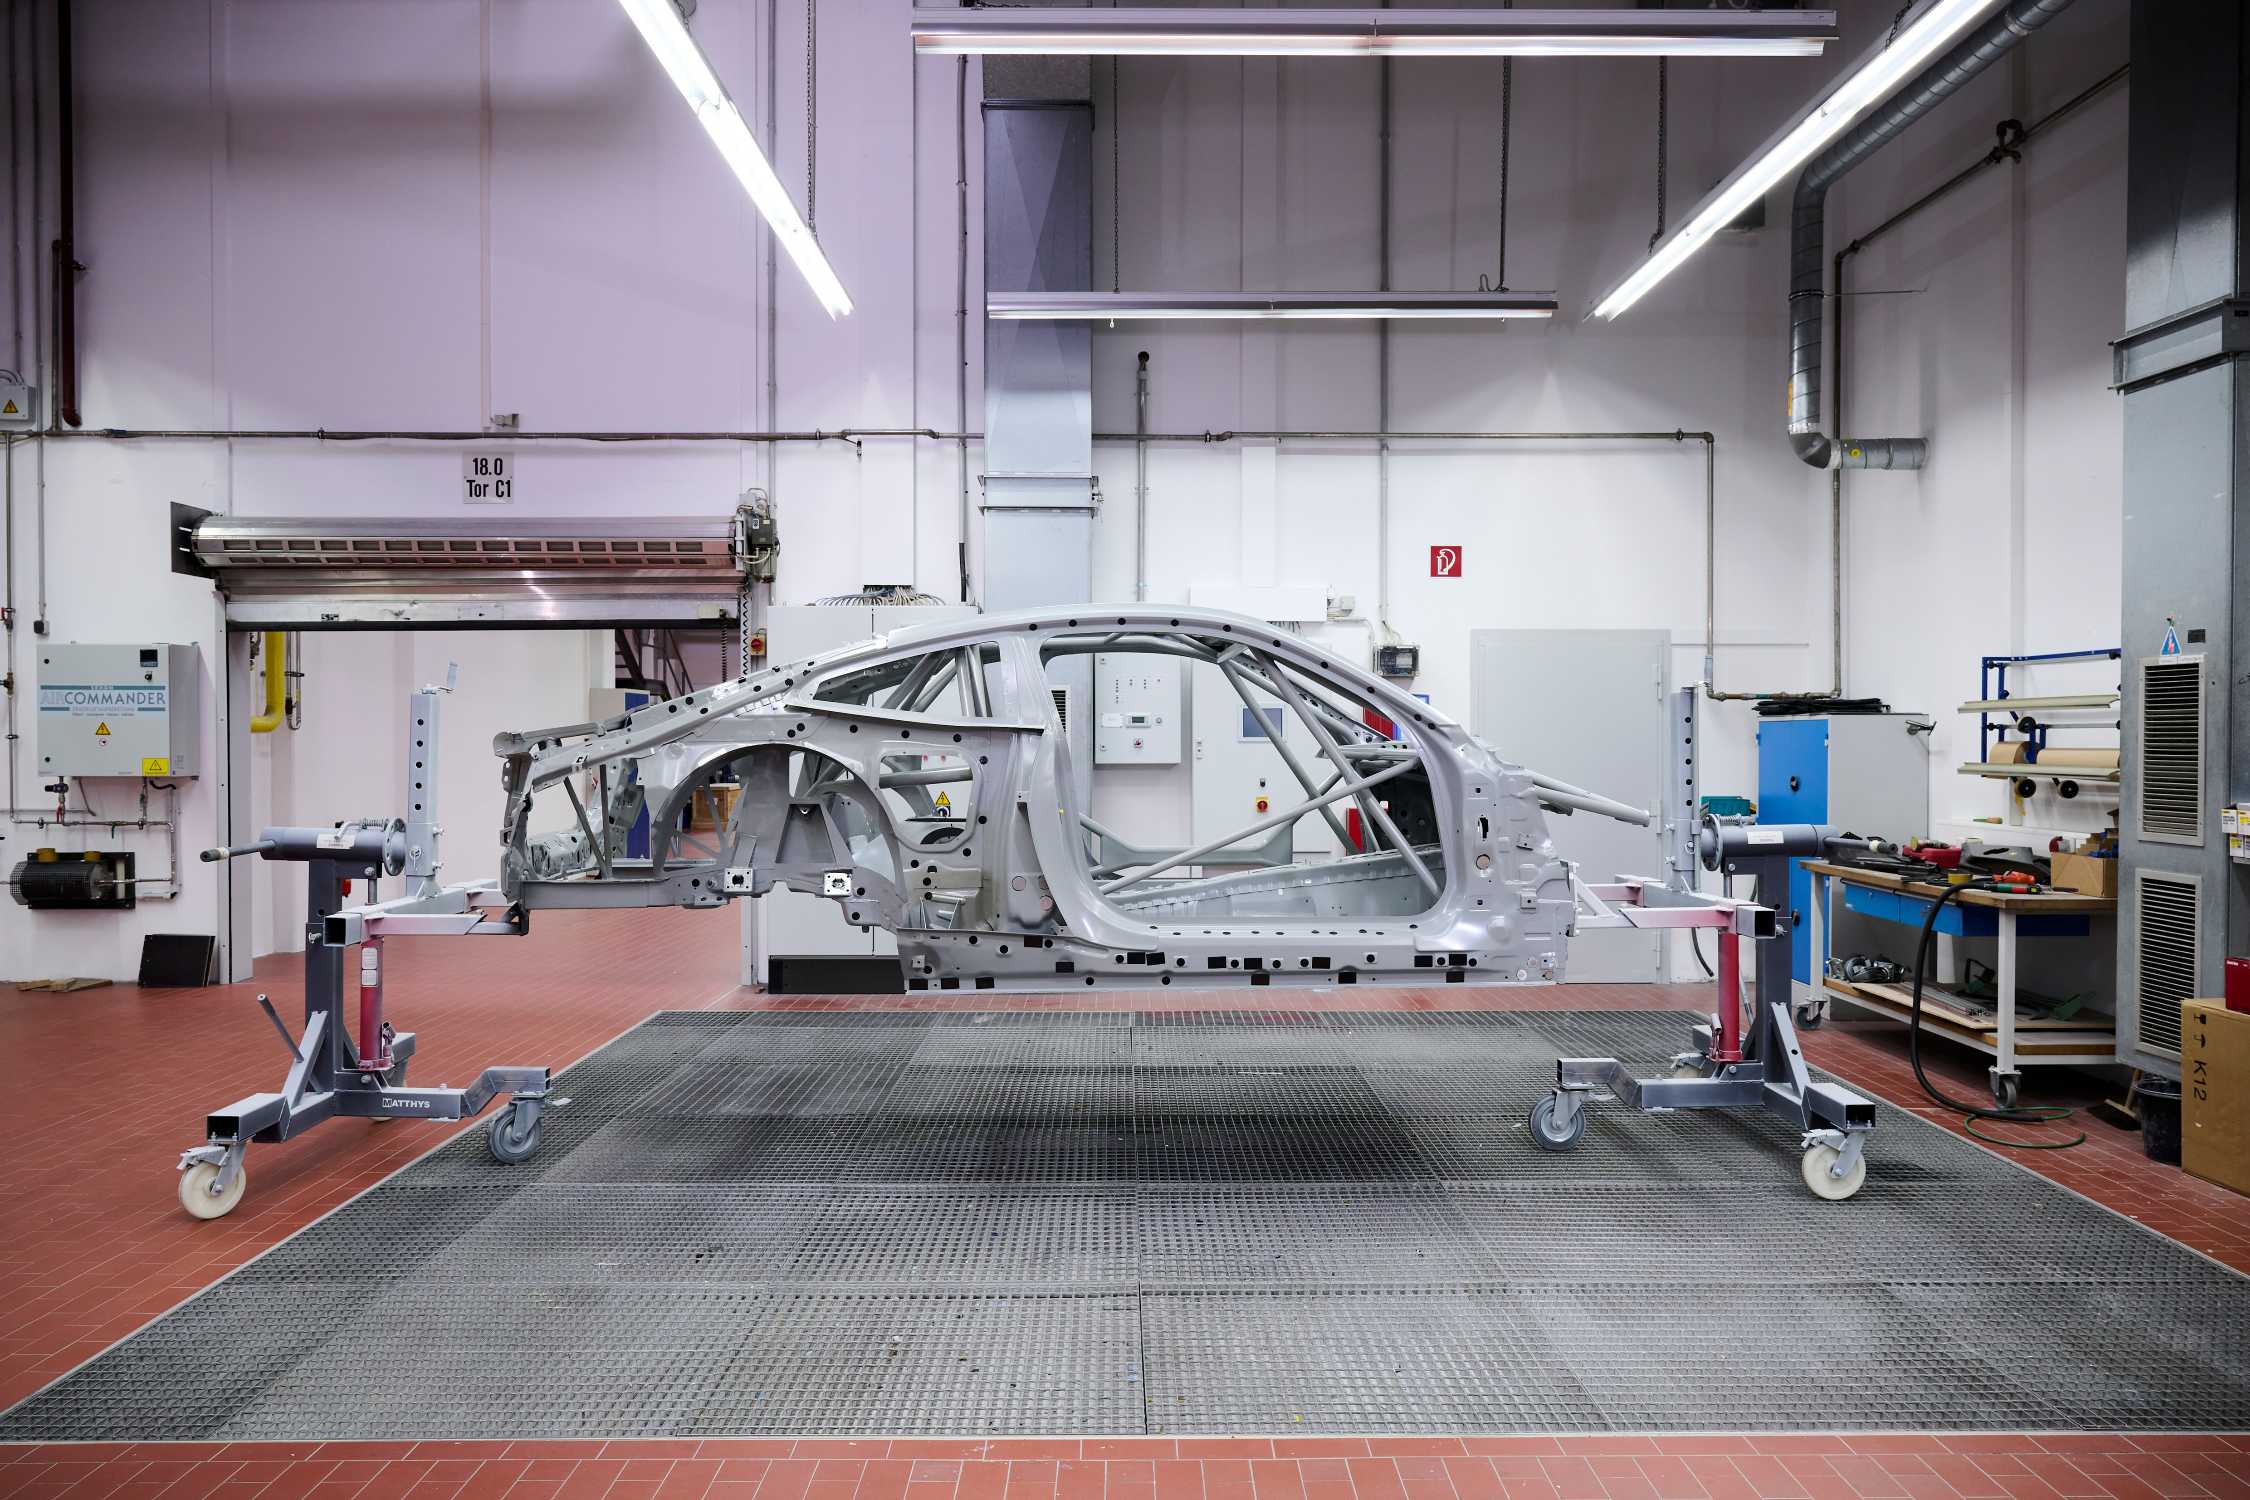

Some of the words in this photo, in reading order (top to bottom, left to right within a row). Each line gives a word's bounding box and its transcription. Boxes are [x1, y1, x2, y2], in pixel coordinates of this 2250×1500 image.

[472, 457, 503, 476] 18.0
[466, 479, 489, 498] Tor
[495, 479, 511, 498] C1
[2193, 1060, 2207, 1101] K12
[382, 1098, 431, 1109] MATTHYS
